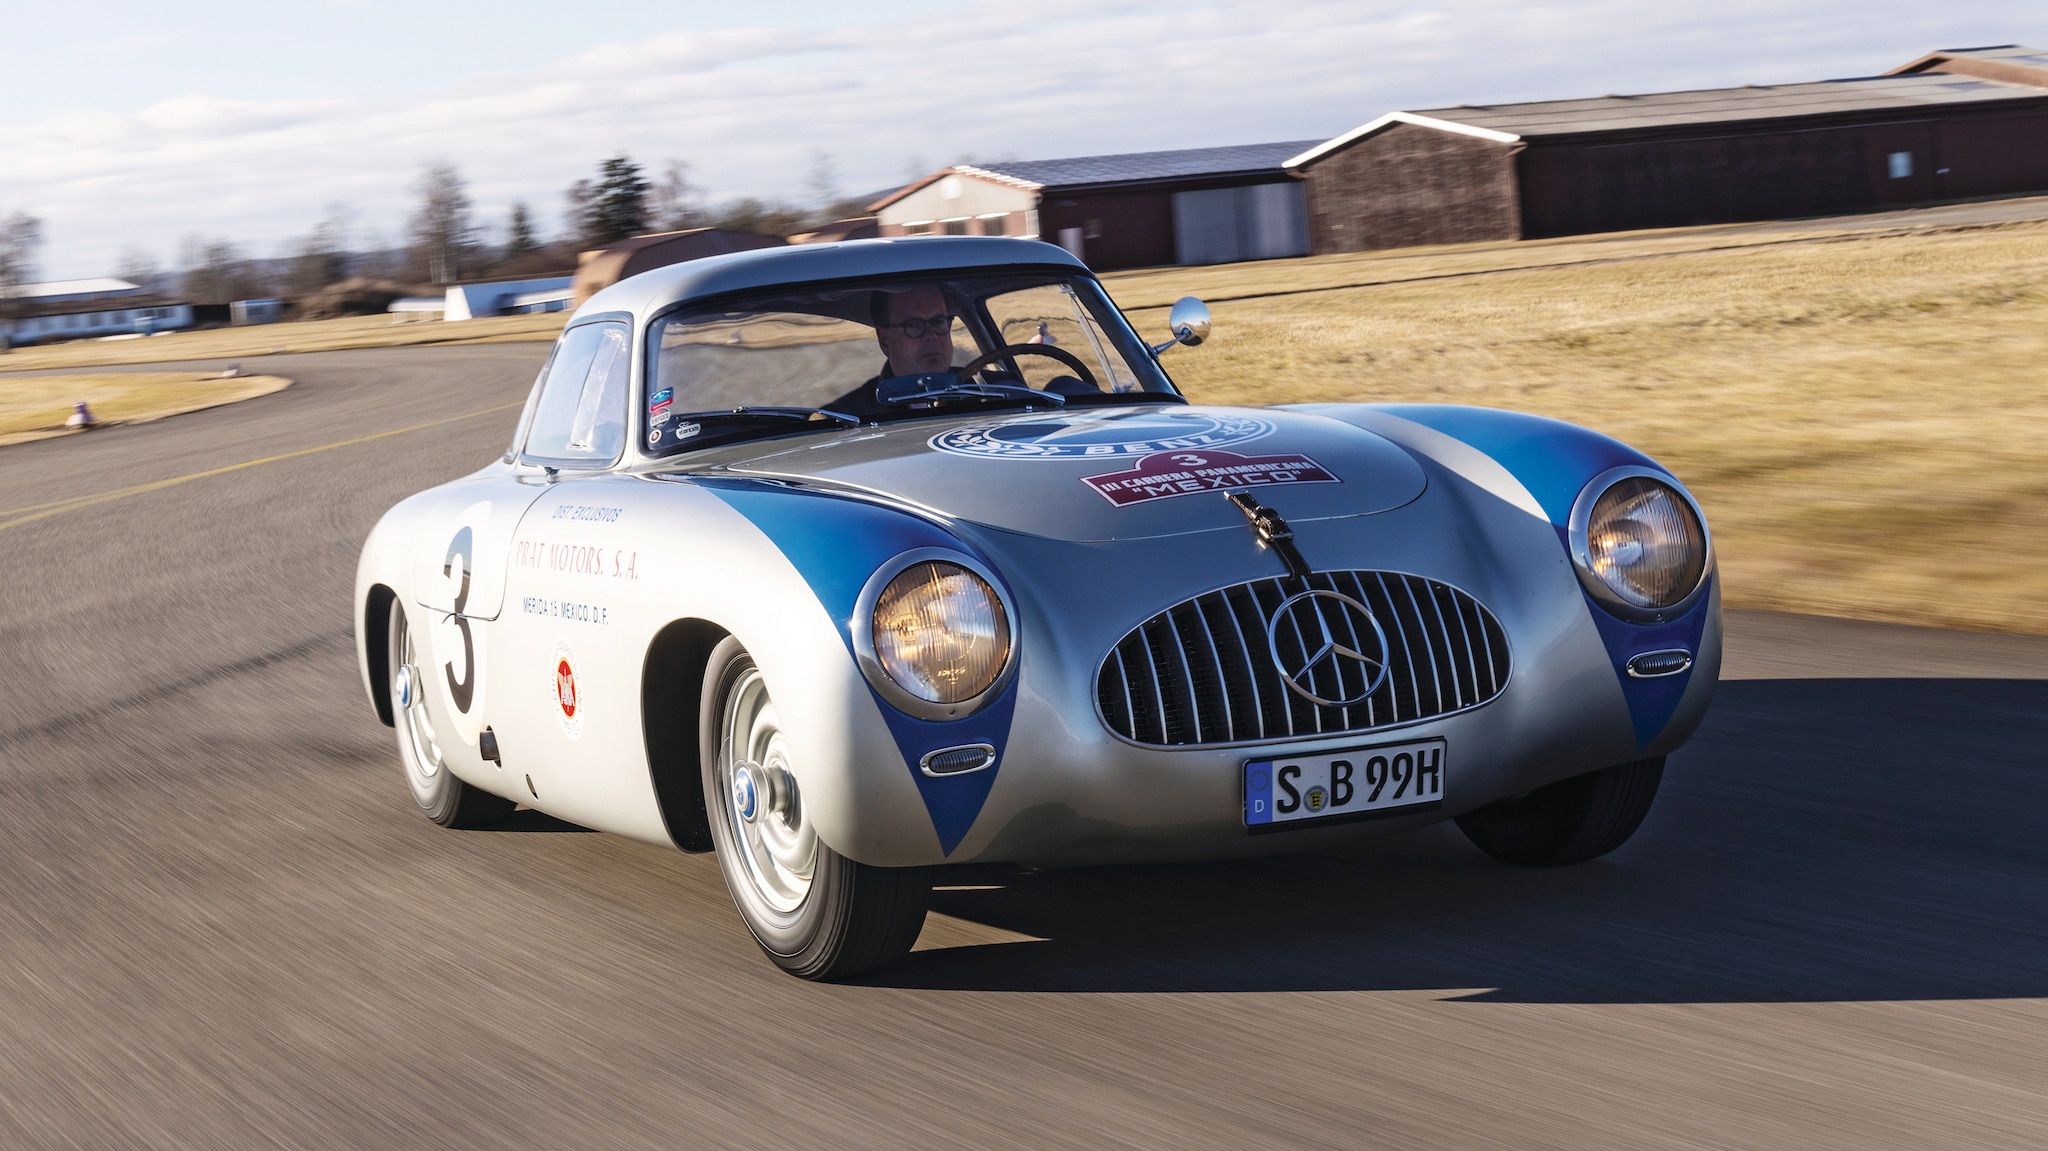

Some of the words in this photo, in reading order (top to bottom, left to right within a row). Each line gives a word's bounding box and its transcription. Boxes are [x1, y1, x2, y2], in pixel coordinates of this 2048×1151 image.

[1084, 435, 1227, 456] BENZ
[1170, 454, 1209, 467] 3
[1101, 481, 1122, 493] III
[1124, 471, 1192, 489] CARRERA
[1197, 461, 1316, 478] PANAMERICANA
[1132, 469, 1302, 497] "MEXICO"
[571, 505, 622, 522] EXCLUSIVOS
[515, 541, 545, 568] PRAT
[523, 596, 548, 615] MERIDA
[550, 600, 558, 616] 15
[443, 525, 475, 714] 3
[1276, 765, 1301, 813] S
[1330, 759, 1354, 807] B
[1366, 748, 1441, 803] 99H
[1254, 799, 1264, 813] D
